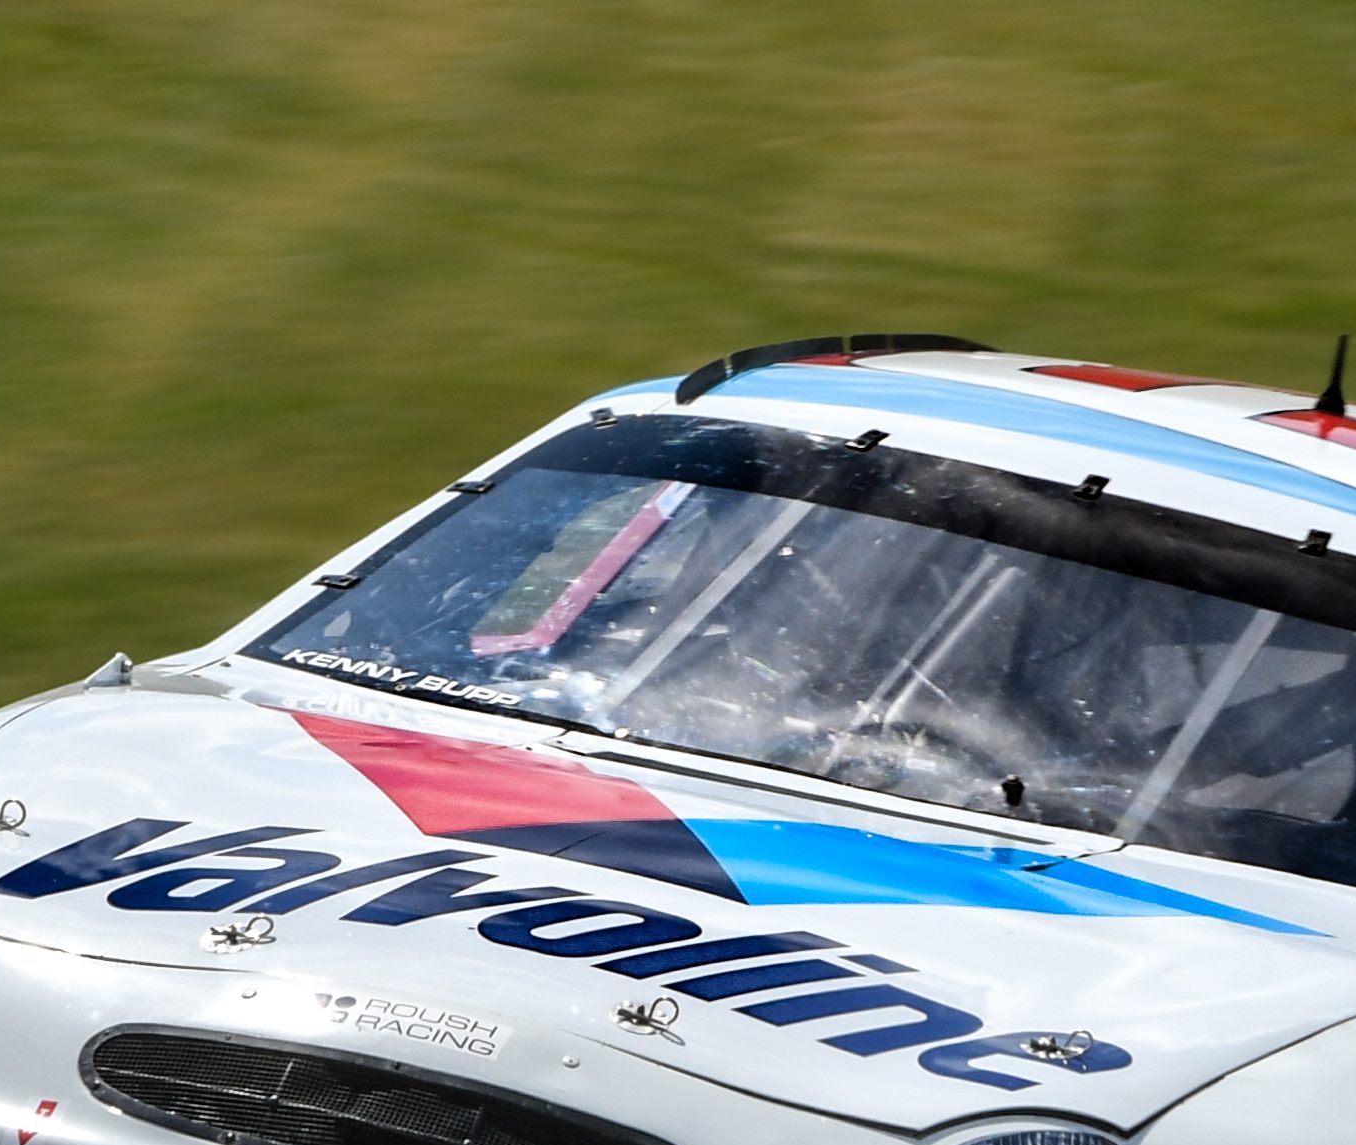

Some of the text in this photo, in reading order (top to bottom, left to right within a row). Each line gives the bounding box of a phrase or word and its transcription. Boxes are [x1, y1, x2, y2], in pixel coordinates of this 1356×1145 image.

[282, 648, 522, 706] KENNY BUPP
[356, 1013, 496, 1057] RACING
[364, 998, 498, 1039] ROUSH
